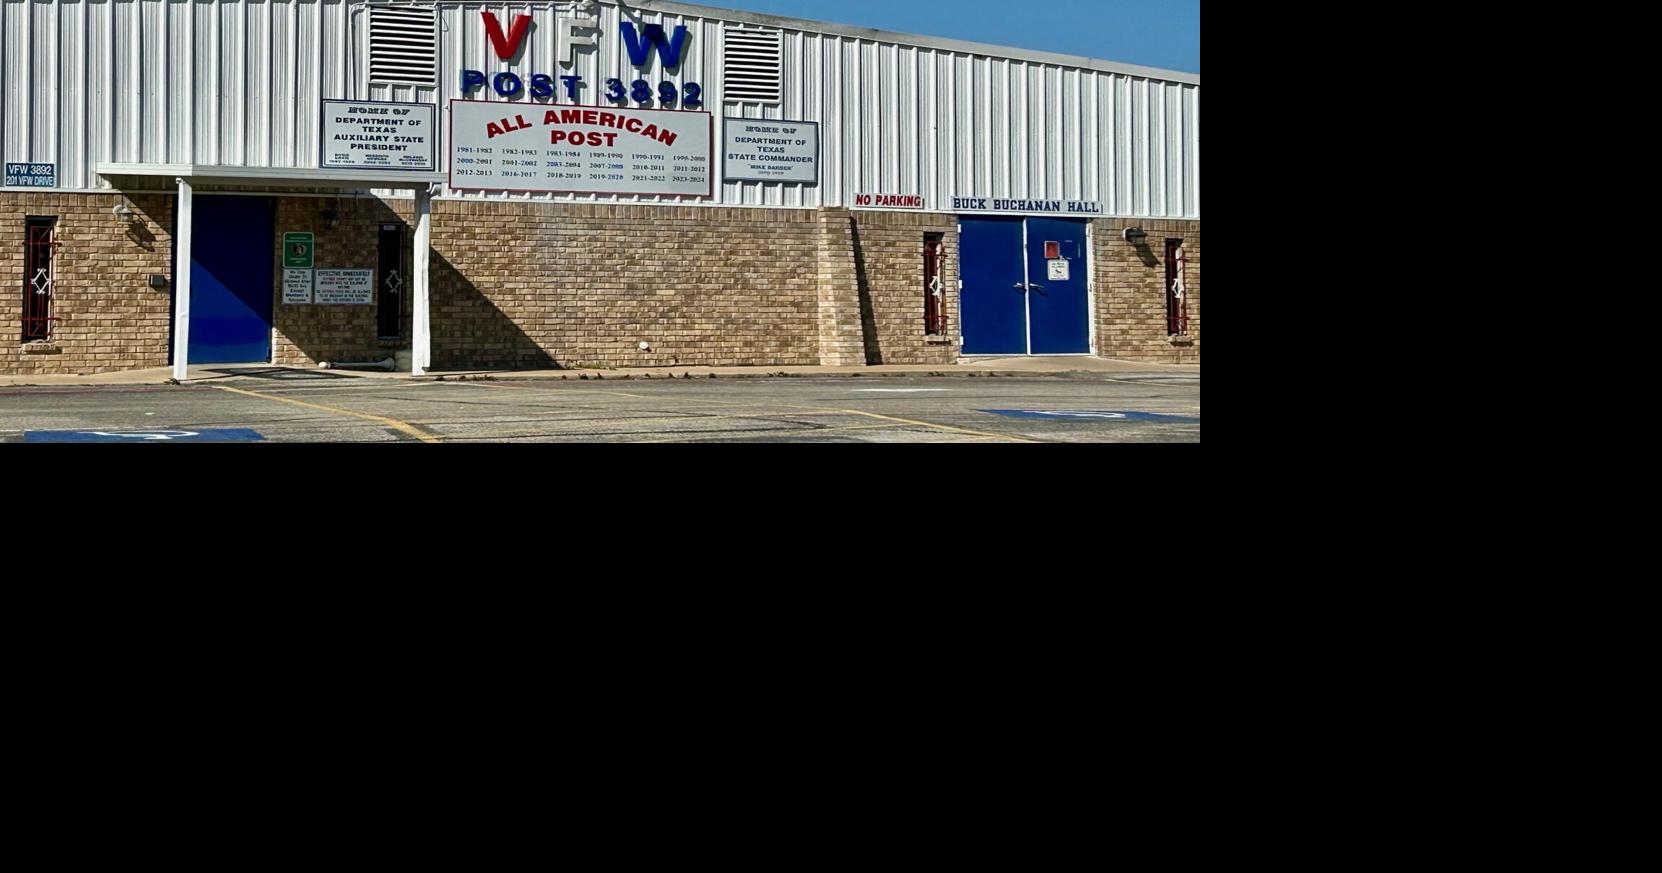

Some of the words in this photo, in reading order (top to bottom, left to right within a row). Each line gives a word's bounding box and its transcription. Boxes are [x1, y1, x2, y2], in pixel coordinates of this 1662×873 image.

[481, 11, 687, 68] VFW
[462, 70, 582, 98] POST
[606, 78, 702, 106] 3892
[348, 106, 388, 114] HOME
[336, 117, 404, 125] DEPARTMENT
[486, 115, 532, 138] ALL
[544, 110, 678, 146] AMERICAN
[551, 130, 618, 147] POST
[758, 155, 813, 163] COMMANDER
[9, 165, 28, 174] VFW
[30, 165, 52, 175] 3892
[6, 176, 17, 185] 201
[19, 176, 33, 185] VFW
[34, 176, 53, 186] DRIVE
[856, 194, 870, 206] NO
[875, 195, 921, 207] PARKING
[954, 198, 987, 210] BUCK
[993, 199, 1060, 212] BUCHANAN
[1068, 202, 1099, 213] HALL
